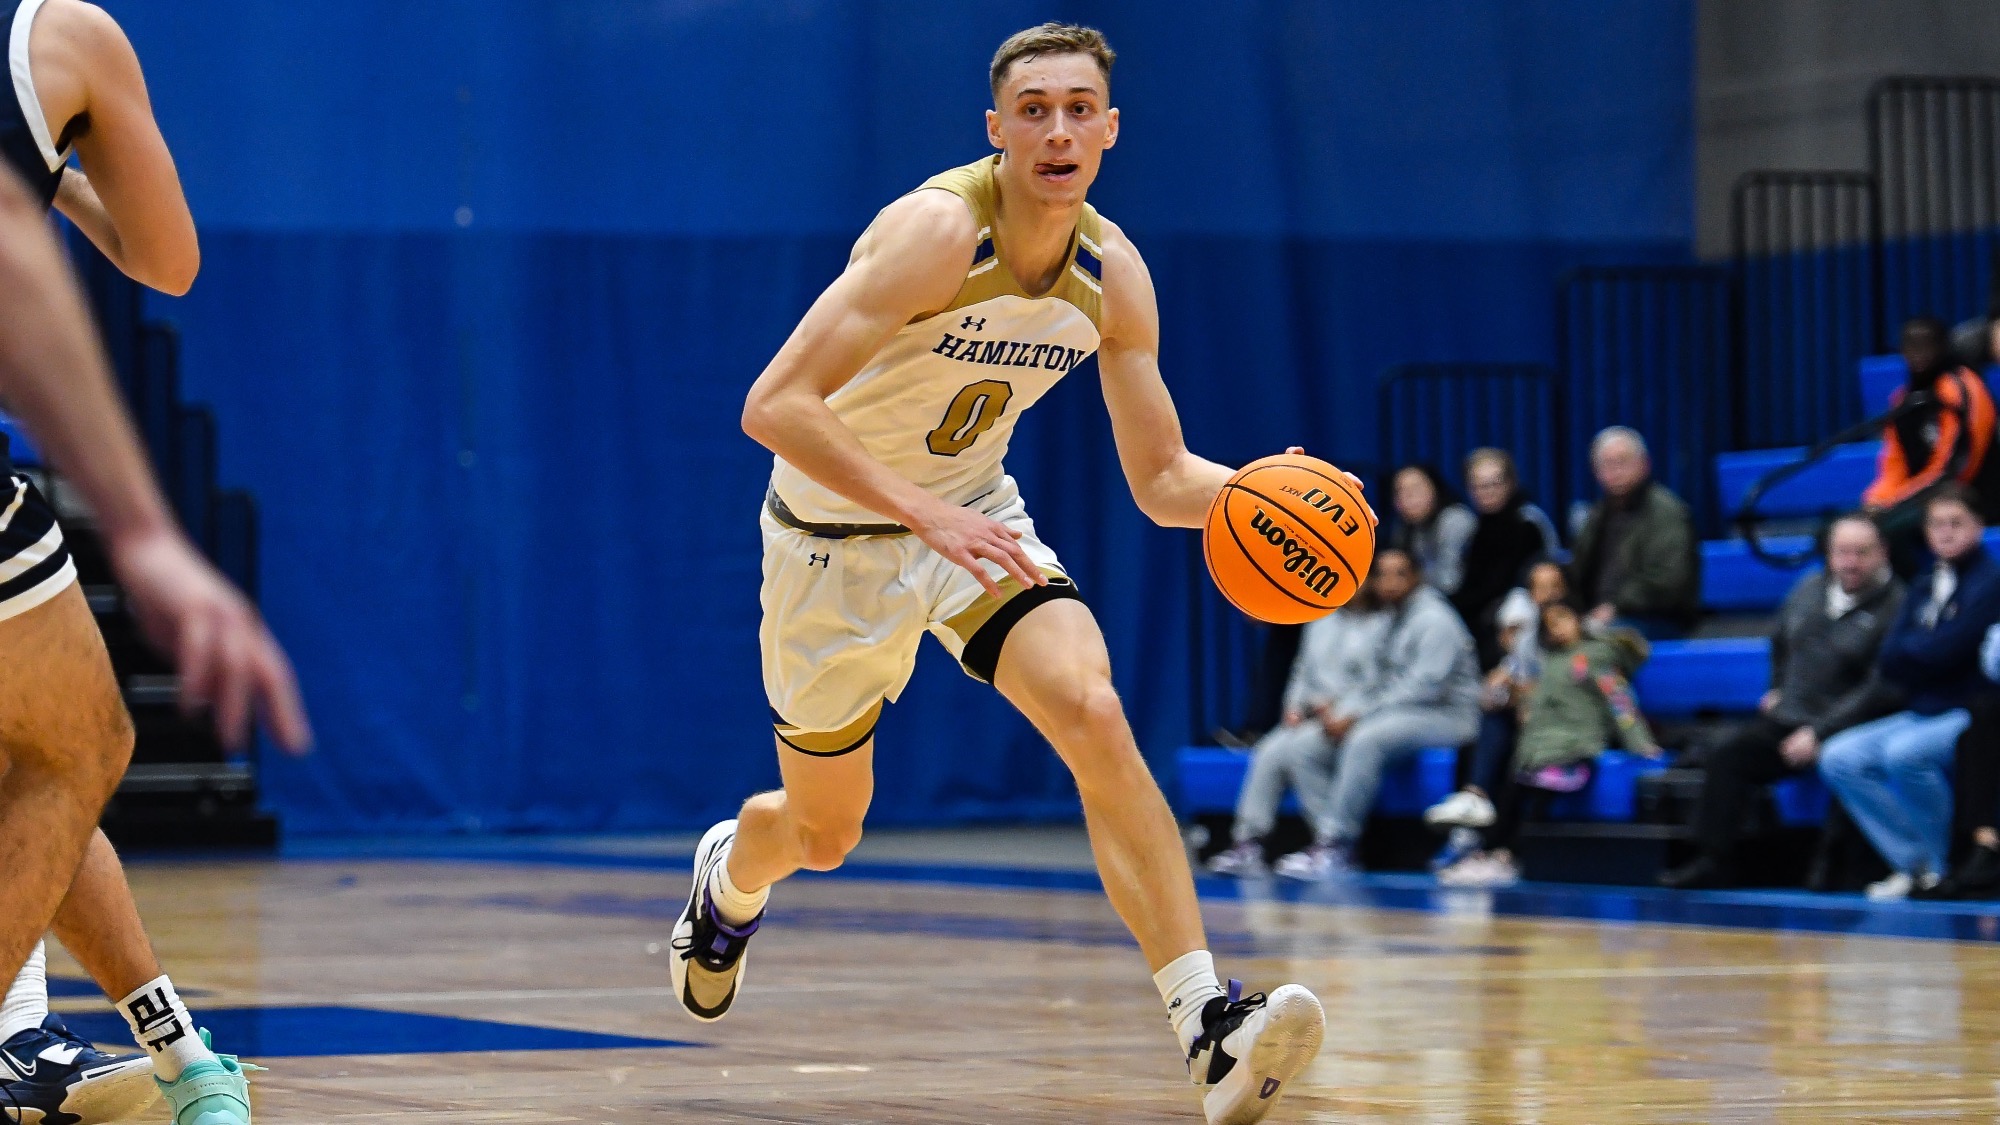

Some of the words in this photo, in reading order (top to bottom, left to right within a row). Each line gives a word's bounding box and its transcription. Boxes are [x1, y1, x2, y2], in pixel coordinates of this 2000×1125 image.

[931, 332, 1086, 372] HAMILTON
[925, 379, 1013, 457] 0
[1279, 485, 1303, 497] NXT
[1301, 487, 1360, 537] EVO
[1250, 508, 1340, 598] Wilson
